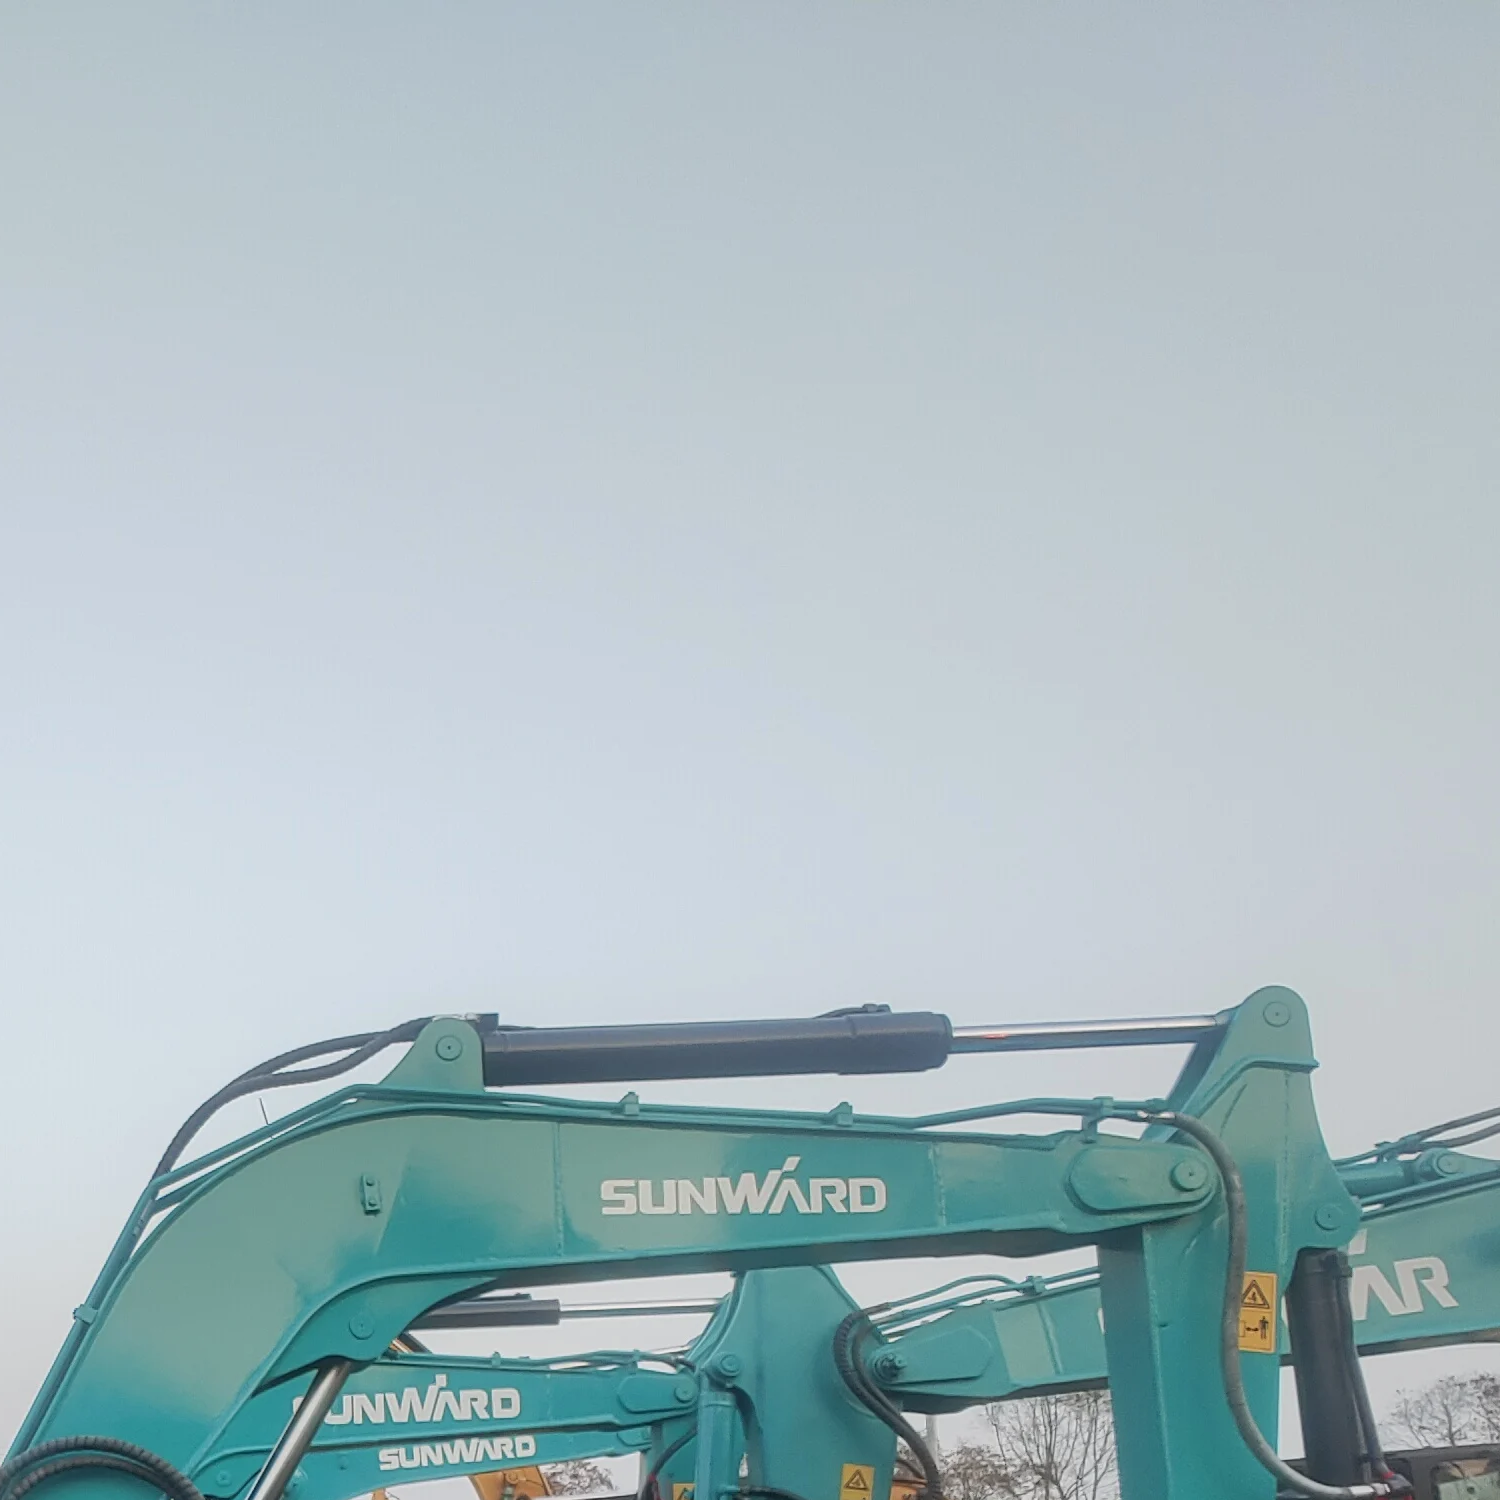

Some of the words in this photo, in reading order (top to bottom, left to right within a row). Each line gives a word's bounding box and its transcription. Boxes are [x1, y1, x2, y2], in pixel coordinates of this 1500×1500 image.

[601, 1155, 887, 1215] SUNWARD
[293, 1373, 521, 1425] UNWARD
[379, 1435, 536, 1471] SUNWARD
